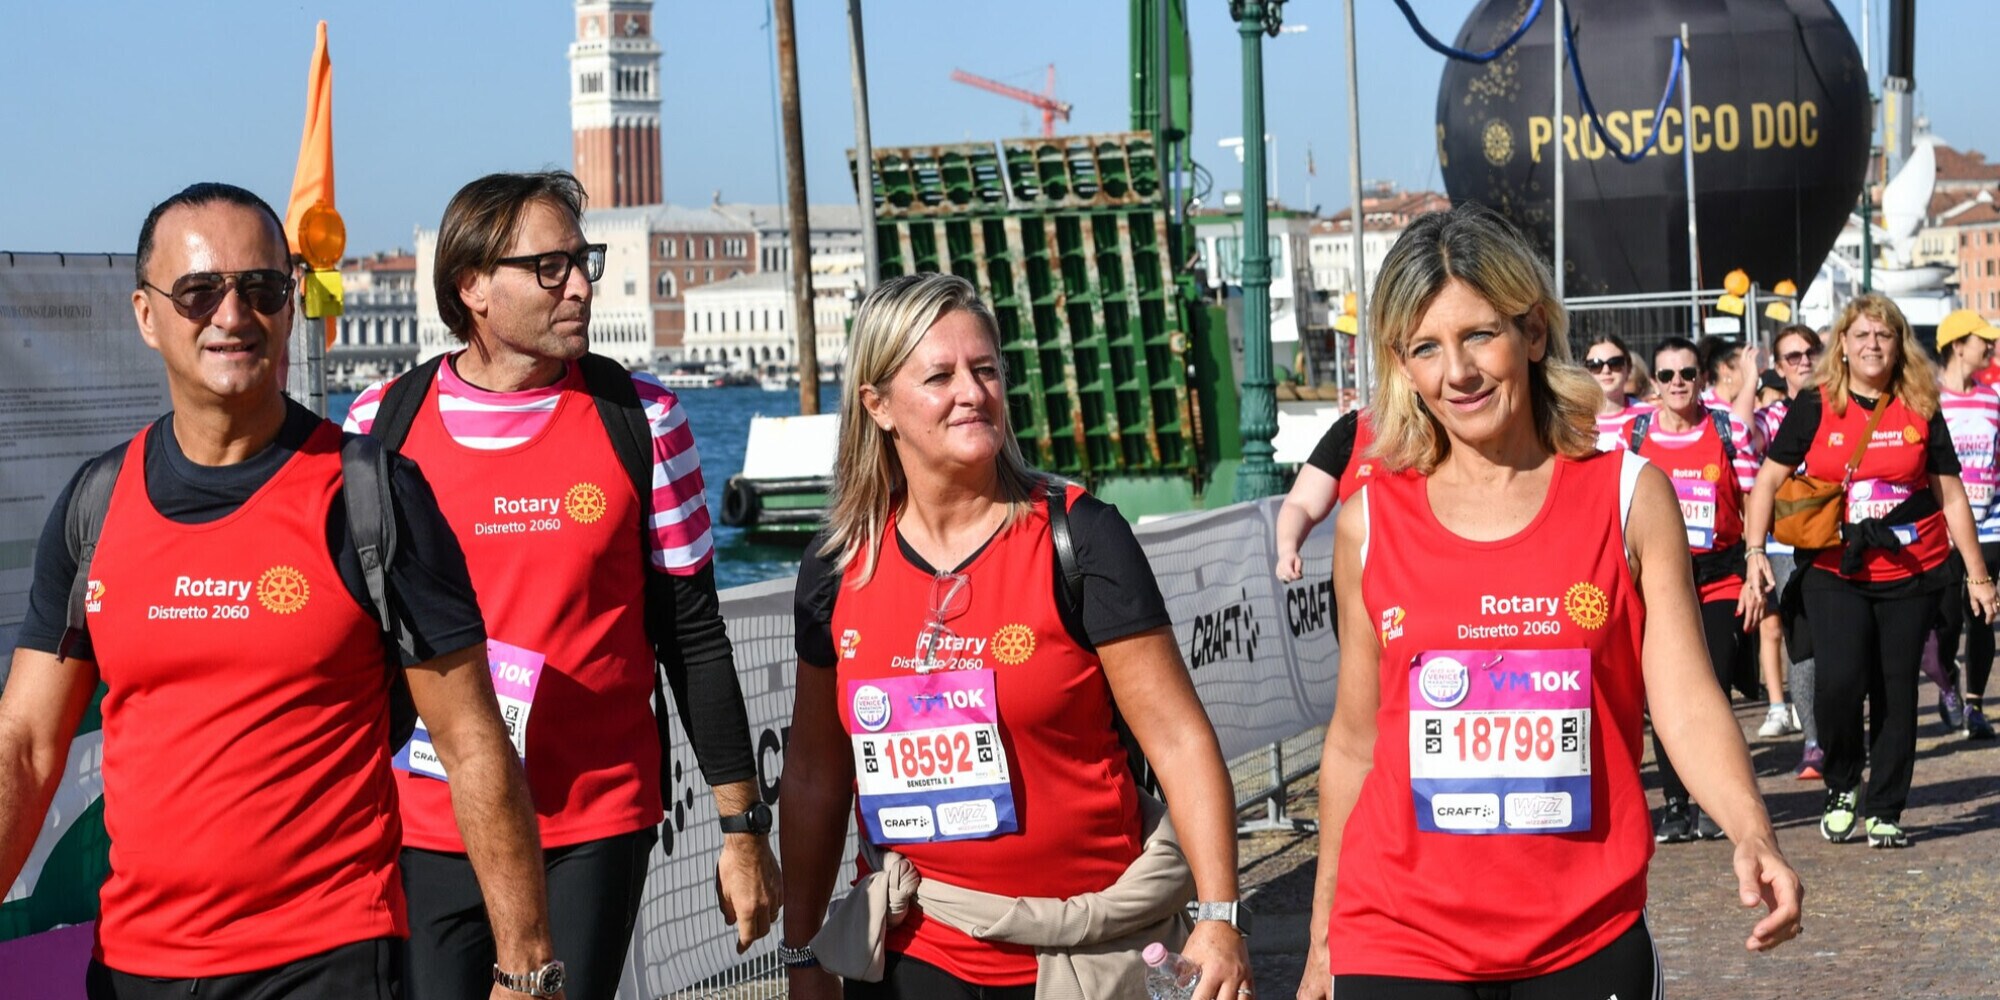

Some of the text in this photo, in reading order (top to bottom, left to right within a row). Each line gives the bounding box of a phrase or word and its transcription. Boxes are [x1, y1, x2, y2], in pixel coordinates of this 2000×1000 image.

[1529, 101, 1819, 163] PROSECCO DOC
[1872, 430, 1902, 440] Rotary
[1673, 469, 1702, 479] Rotary
[1965, 486, 1985, 499] 523
[494, 496, 561, 516] Rotary
[475, 518, 561, 536] Distretto 2060
[174, 576, 252, 601] Rotary
[148, 605, 249, 620] Distretto 2060
[1481, 595, 1559, 616] Rotary
[1191, 605, 1241, 670] CRAFT
[1458, 621, 1561, 639] Distretto 2060
[920, 632, 987, 655] Rotary
[949, 657, 983, 670] 2060
[1489, 670, 1581, 692] VM10K
[1453, 716, 1555, 762] 18798
[413, 751, 438, 763] CRA
[884, 731, 973, 780] 18592
[907, 778, 942, 788] BENEDETTA
[1437, 807, 1481, 817] CRAFT
[884, 817, 918, 828] CRAFT
